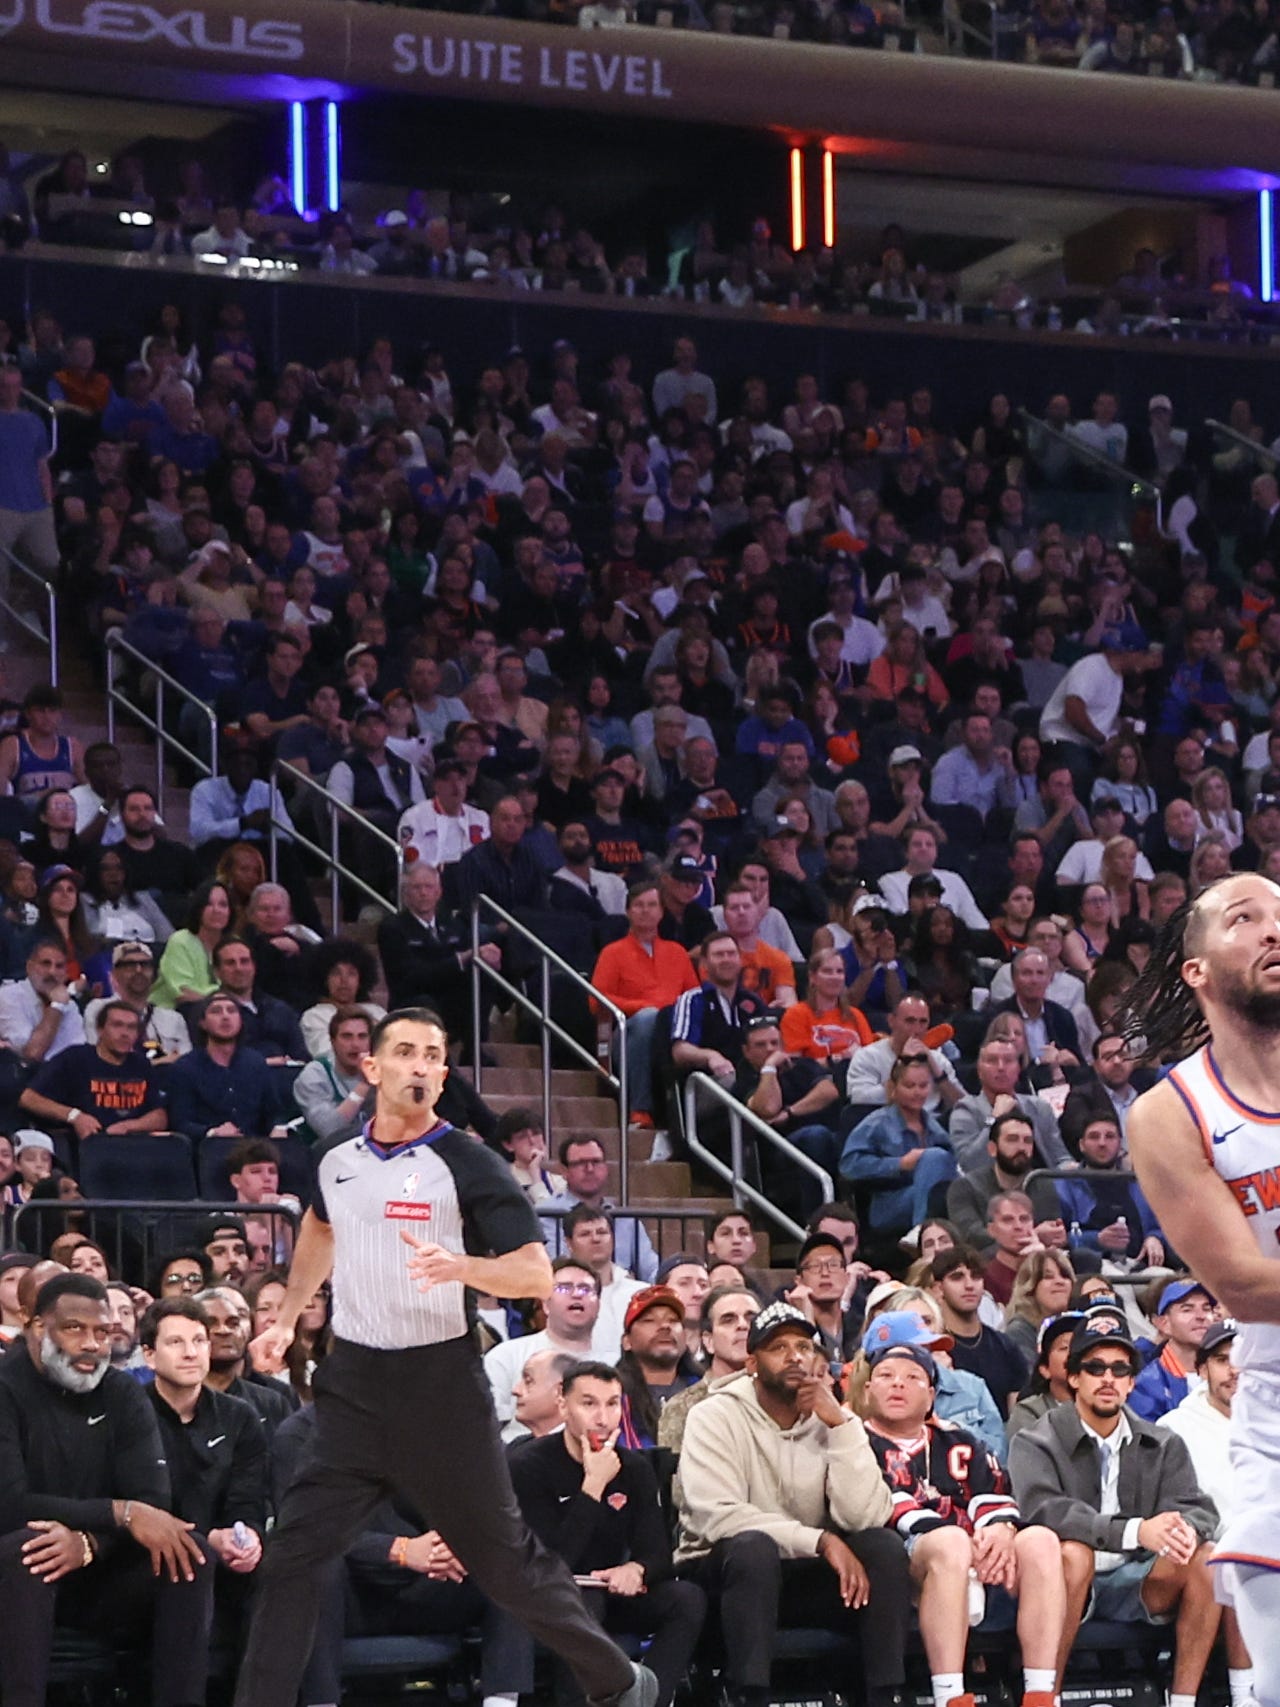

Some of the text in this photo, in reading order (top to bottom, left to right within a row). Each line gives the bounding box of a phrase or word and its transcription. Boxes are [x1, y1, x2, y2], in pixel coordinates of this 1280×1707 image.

[36, 0, 304, 60] LEXUS
[392, 33, 673, 99] SUITE LEVEL
[947, 1444, 973, 1481] C
